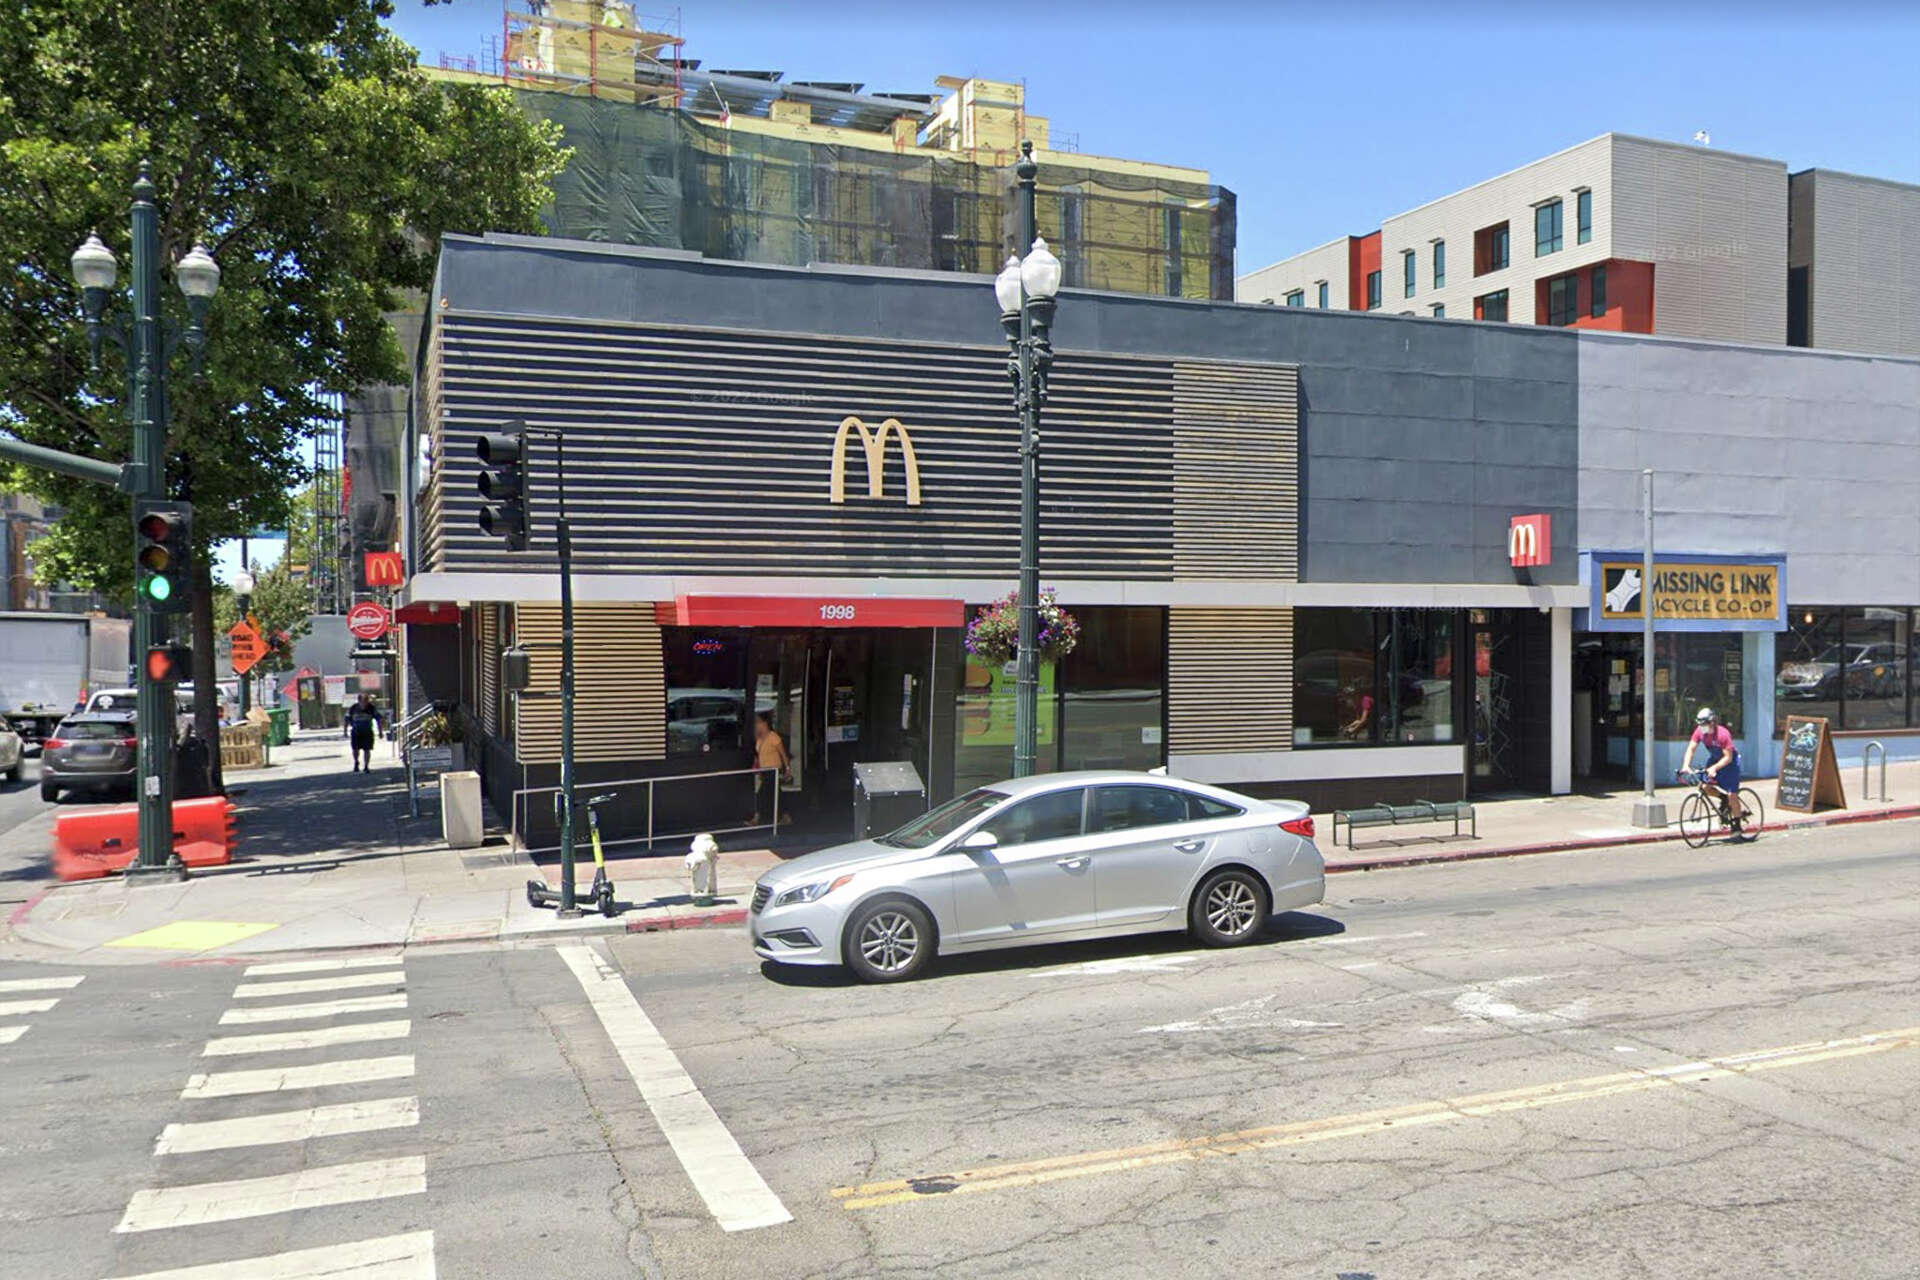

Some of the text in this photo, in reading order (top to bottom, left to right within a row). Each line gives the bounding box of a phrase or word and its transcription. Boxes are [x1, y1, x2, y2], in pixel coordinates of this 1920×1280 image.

[1730, 573, 1772, 595] LINK
[819, 605, 856, 620] 1998
[1652, 598, 1772, 613] ICYCLE CO-OP
